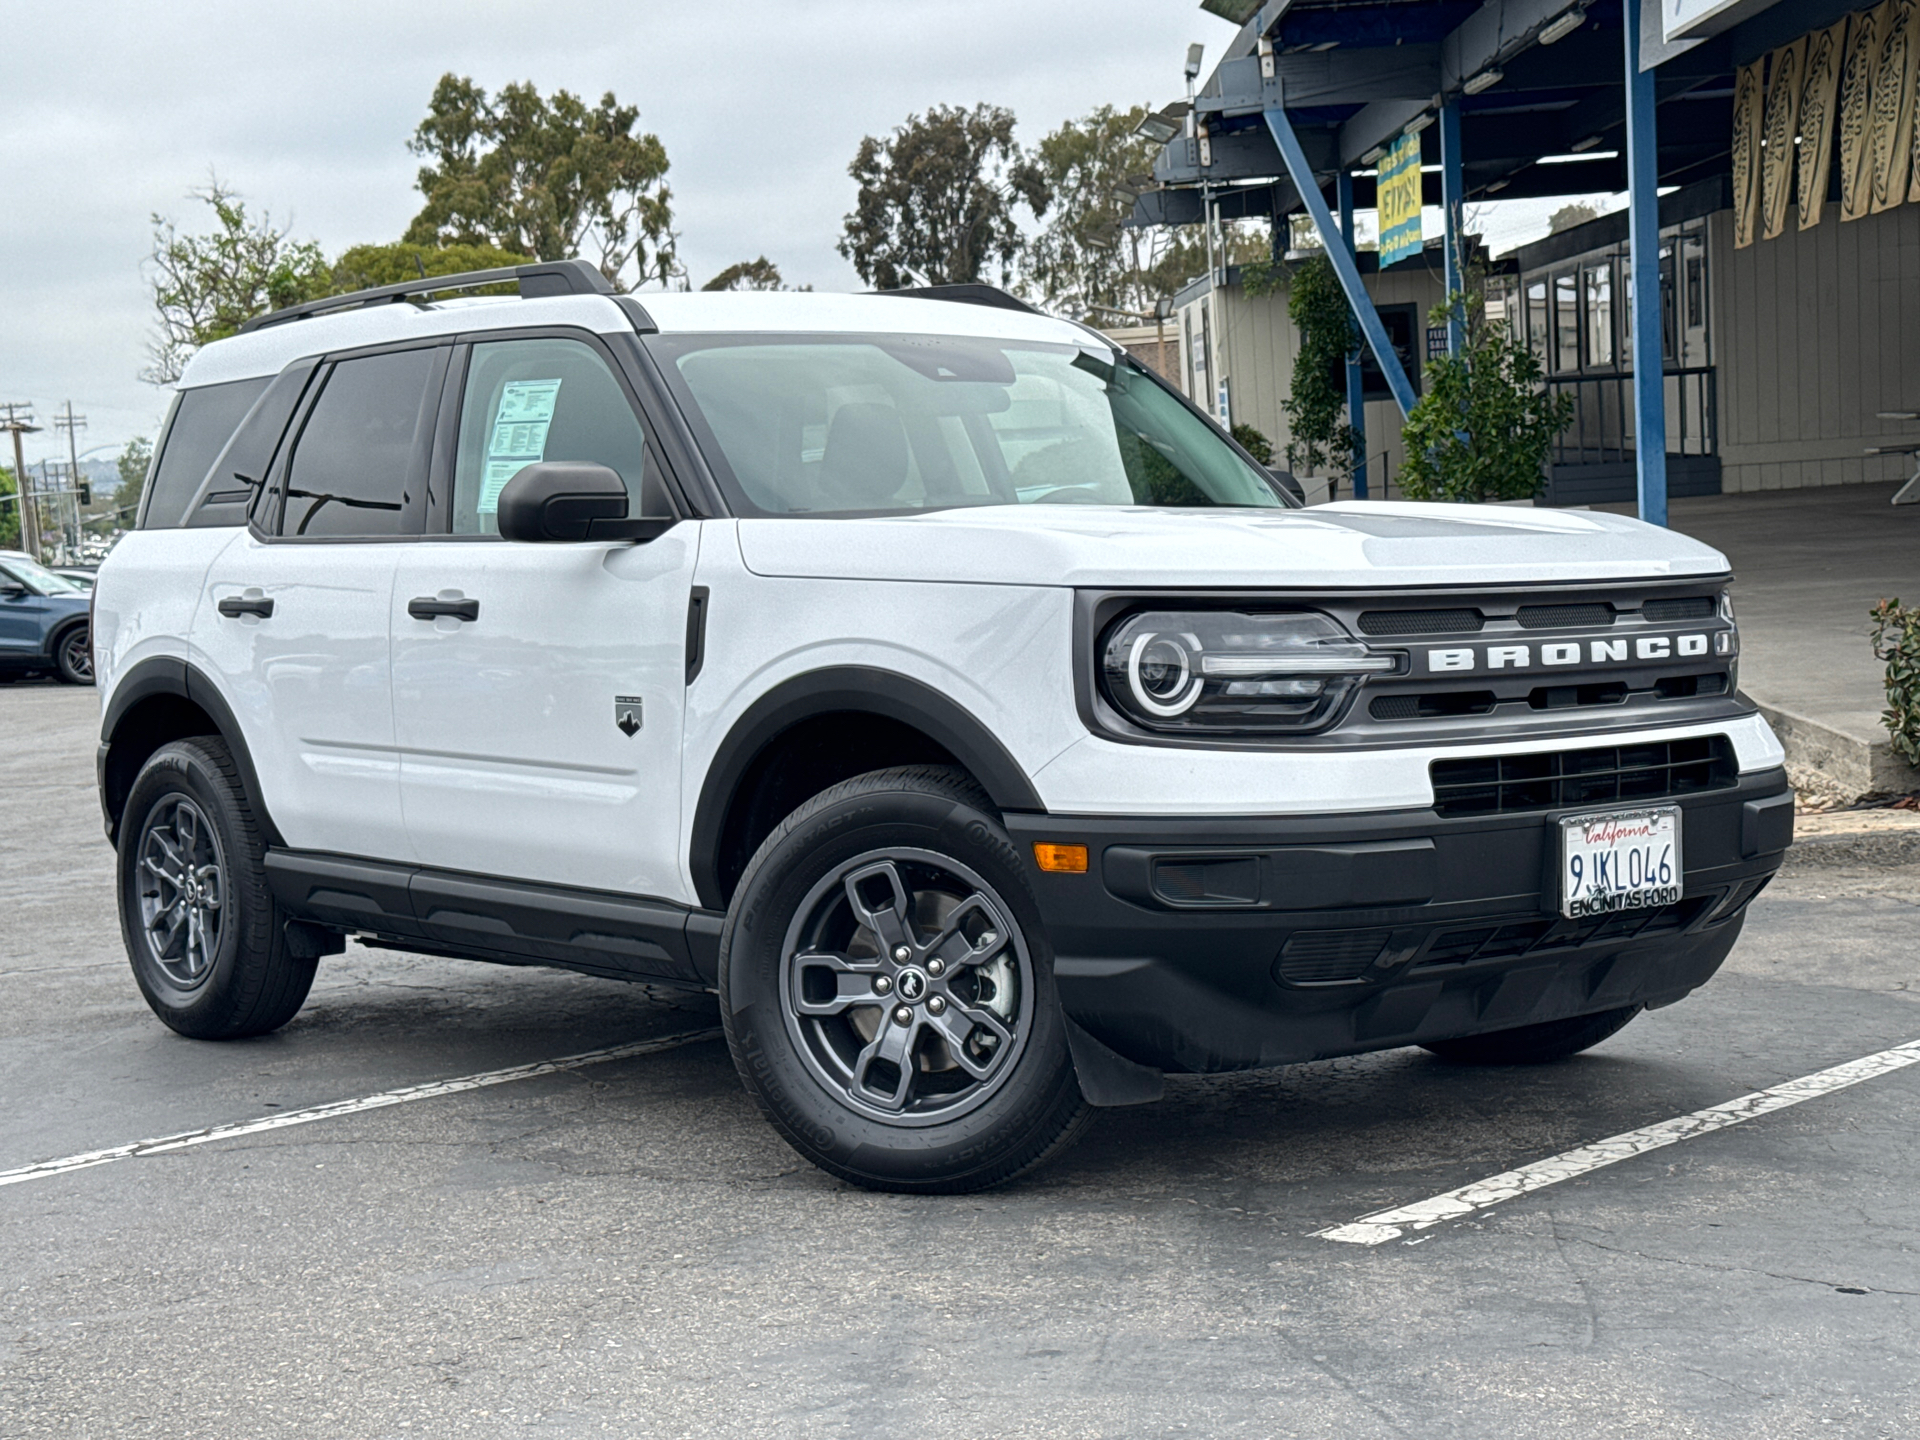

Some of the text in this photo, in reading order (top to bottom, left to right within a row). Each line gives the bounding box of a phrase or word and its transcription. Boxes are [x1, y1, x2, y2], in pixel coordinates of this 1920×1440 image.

[1429, 330, 1447, 339] FLEE
[1428, 634, 1707, 672] BRONCO
[1585, 821, 1657, 847] California
[1570, 841, 1671, 898] 9JKL046
[1569, 887, 1678, 917] ENCINITAS FORD
